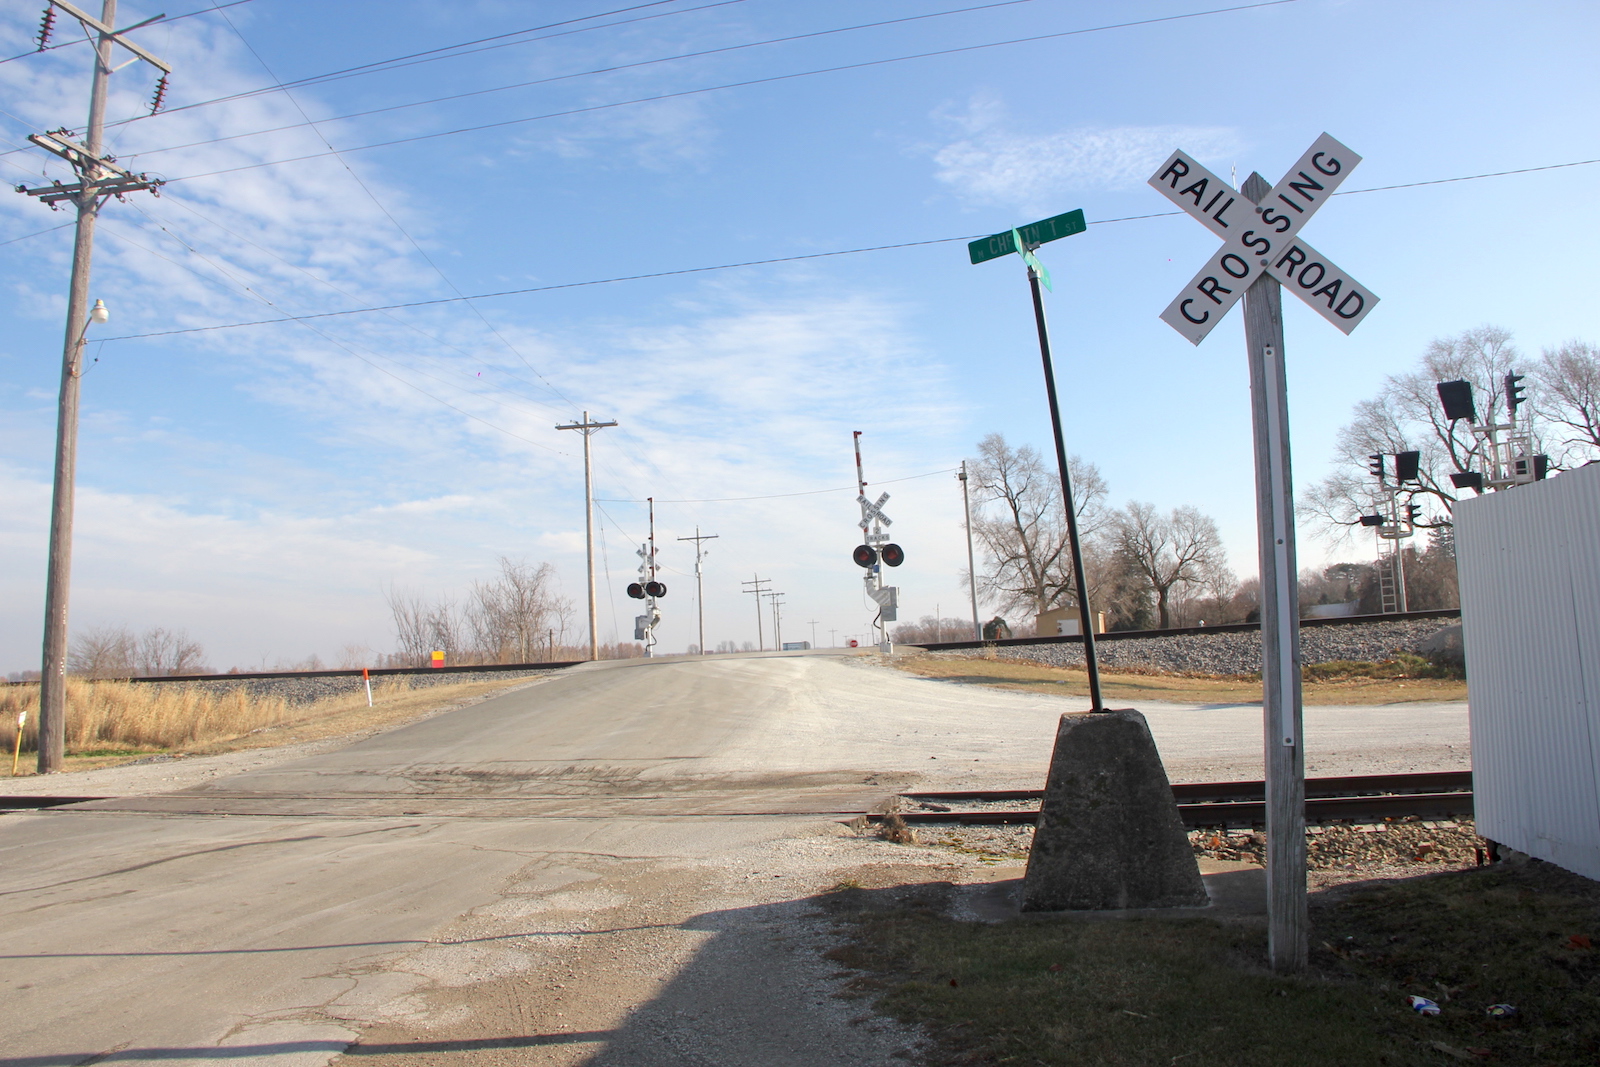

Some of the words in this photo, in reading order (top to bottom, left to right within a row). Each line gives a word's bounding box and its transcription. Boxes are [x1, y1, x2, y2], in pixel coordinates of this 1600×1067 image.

[1159, 158, 1236, 229] RAIL
[977, 250, 985, 259] N
[1065, 221, 1078, 233] ST
[1180, 151, 1342, 325] CROSSING
[1275, 244, 1365, 320] ROAD
[857, 495, 872, 511] RAIL
[860, 492, 889, 528] CROSSING
[876, 511, 891, 527] ROAD
